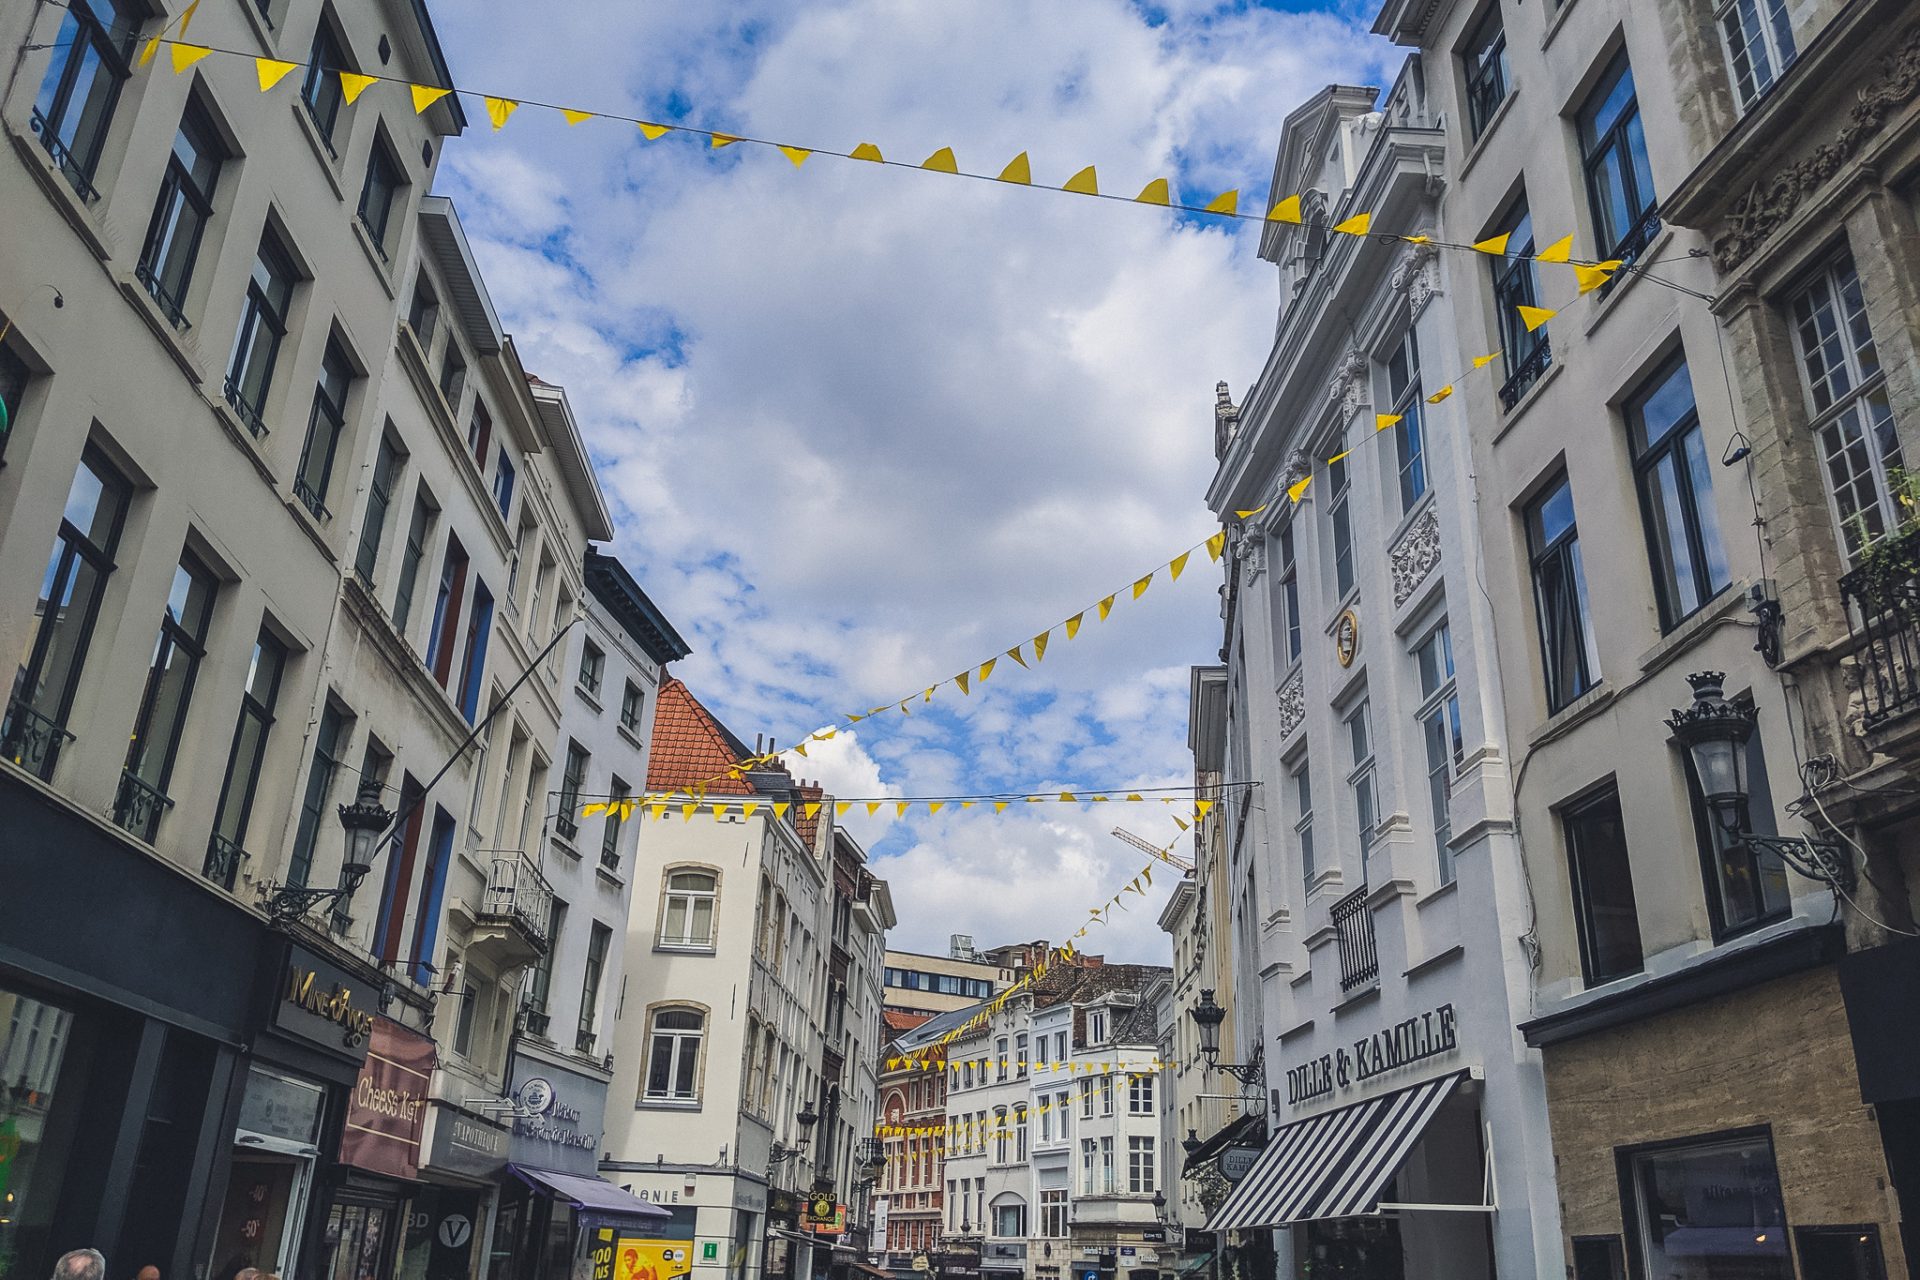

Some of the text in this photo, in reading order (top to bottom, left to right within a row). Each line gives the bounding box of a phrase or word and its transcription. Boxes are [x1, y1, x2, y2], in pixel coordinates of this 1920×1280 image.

[1286, 1002, 1457, 1105] DILLE & KAMILLE
[809, 1192, 836, 1202] GOLD
[408, 1212, 430, 1228] BD
